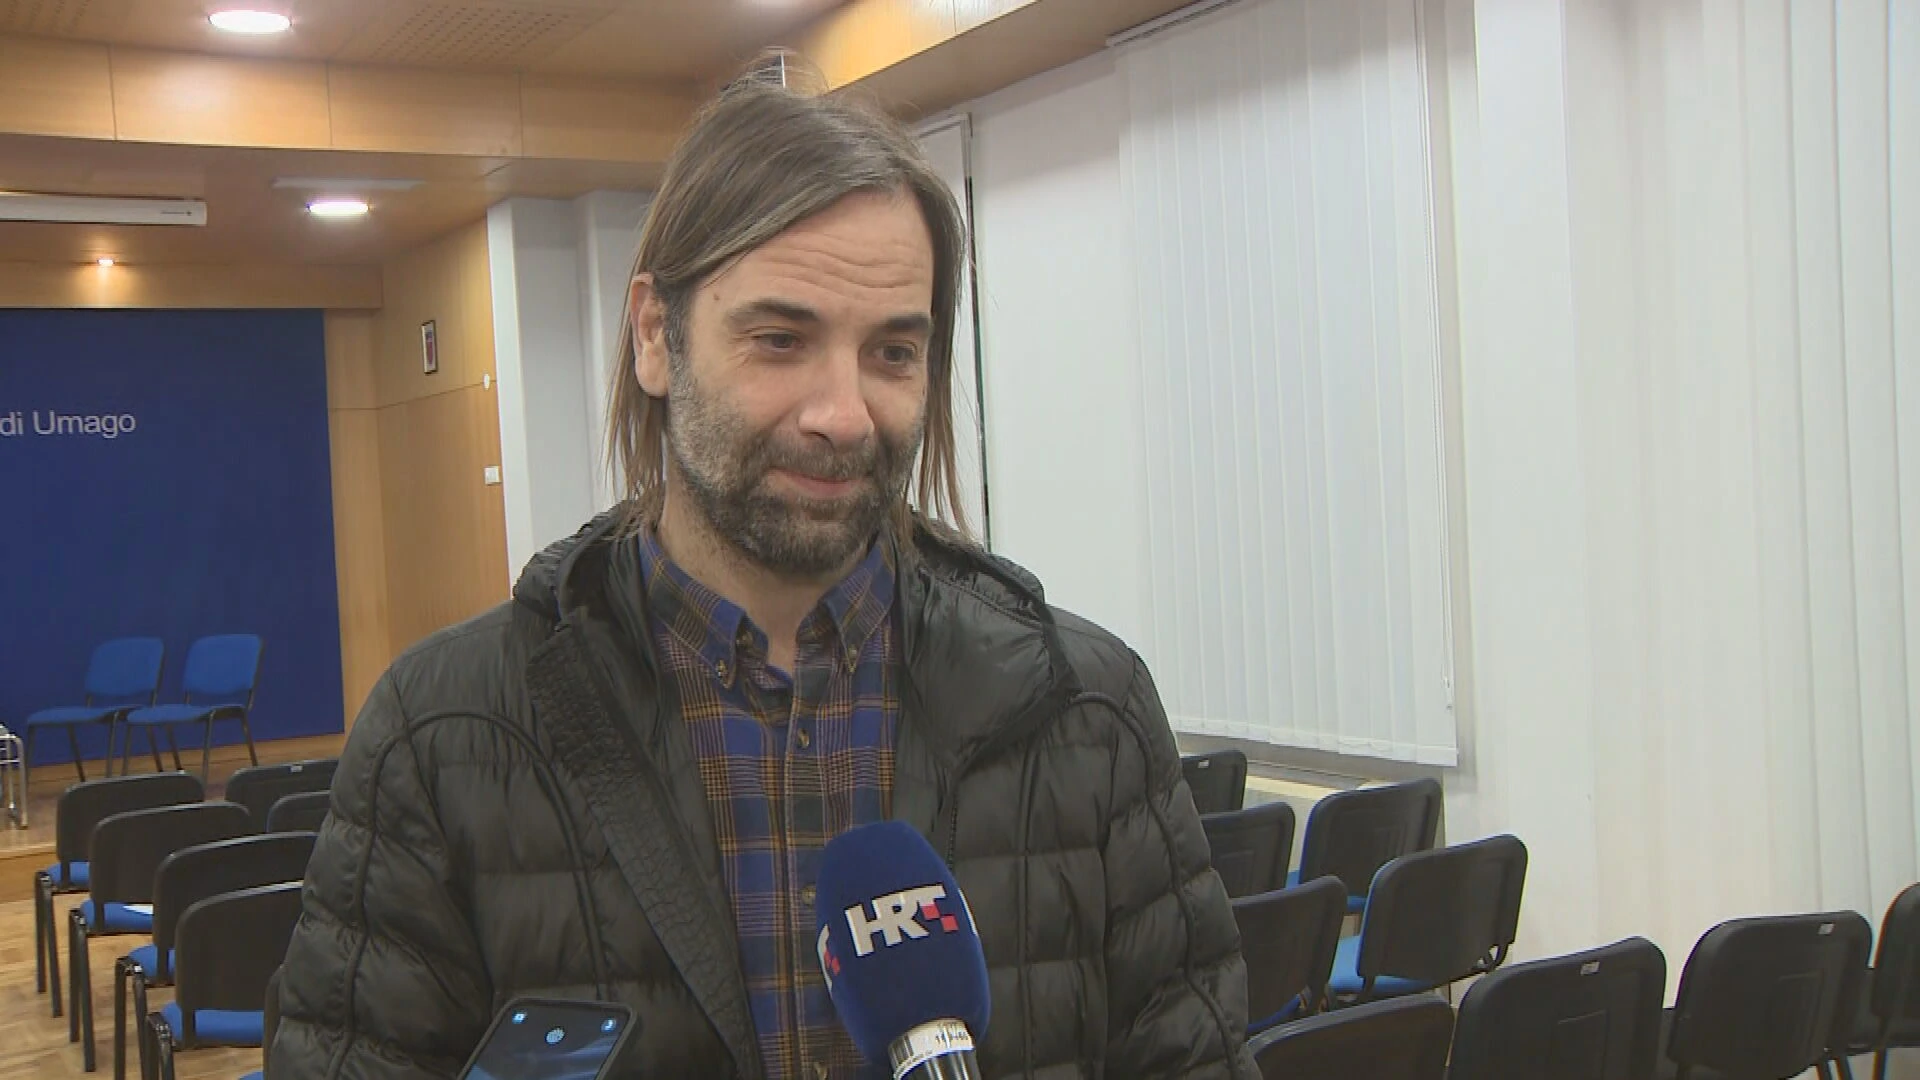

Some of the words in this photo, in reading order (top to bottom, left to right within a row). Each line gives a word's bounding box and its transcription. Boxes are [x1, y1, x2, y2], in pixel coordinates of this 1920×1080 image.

[0, 411, 24, 436] di
[33, 410, 136, 439] Umago
[844, 882, 958, 957] HRT
